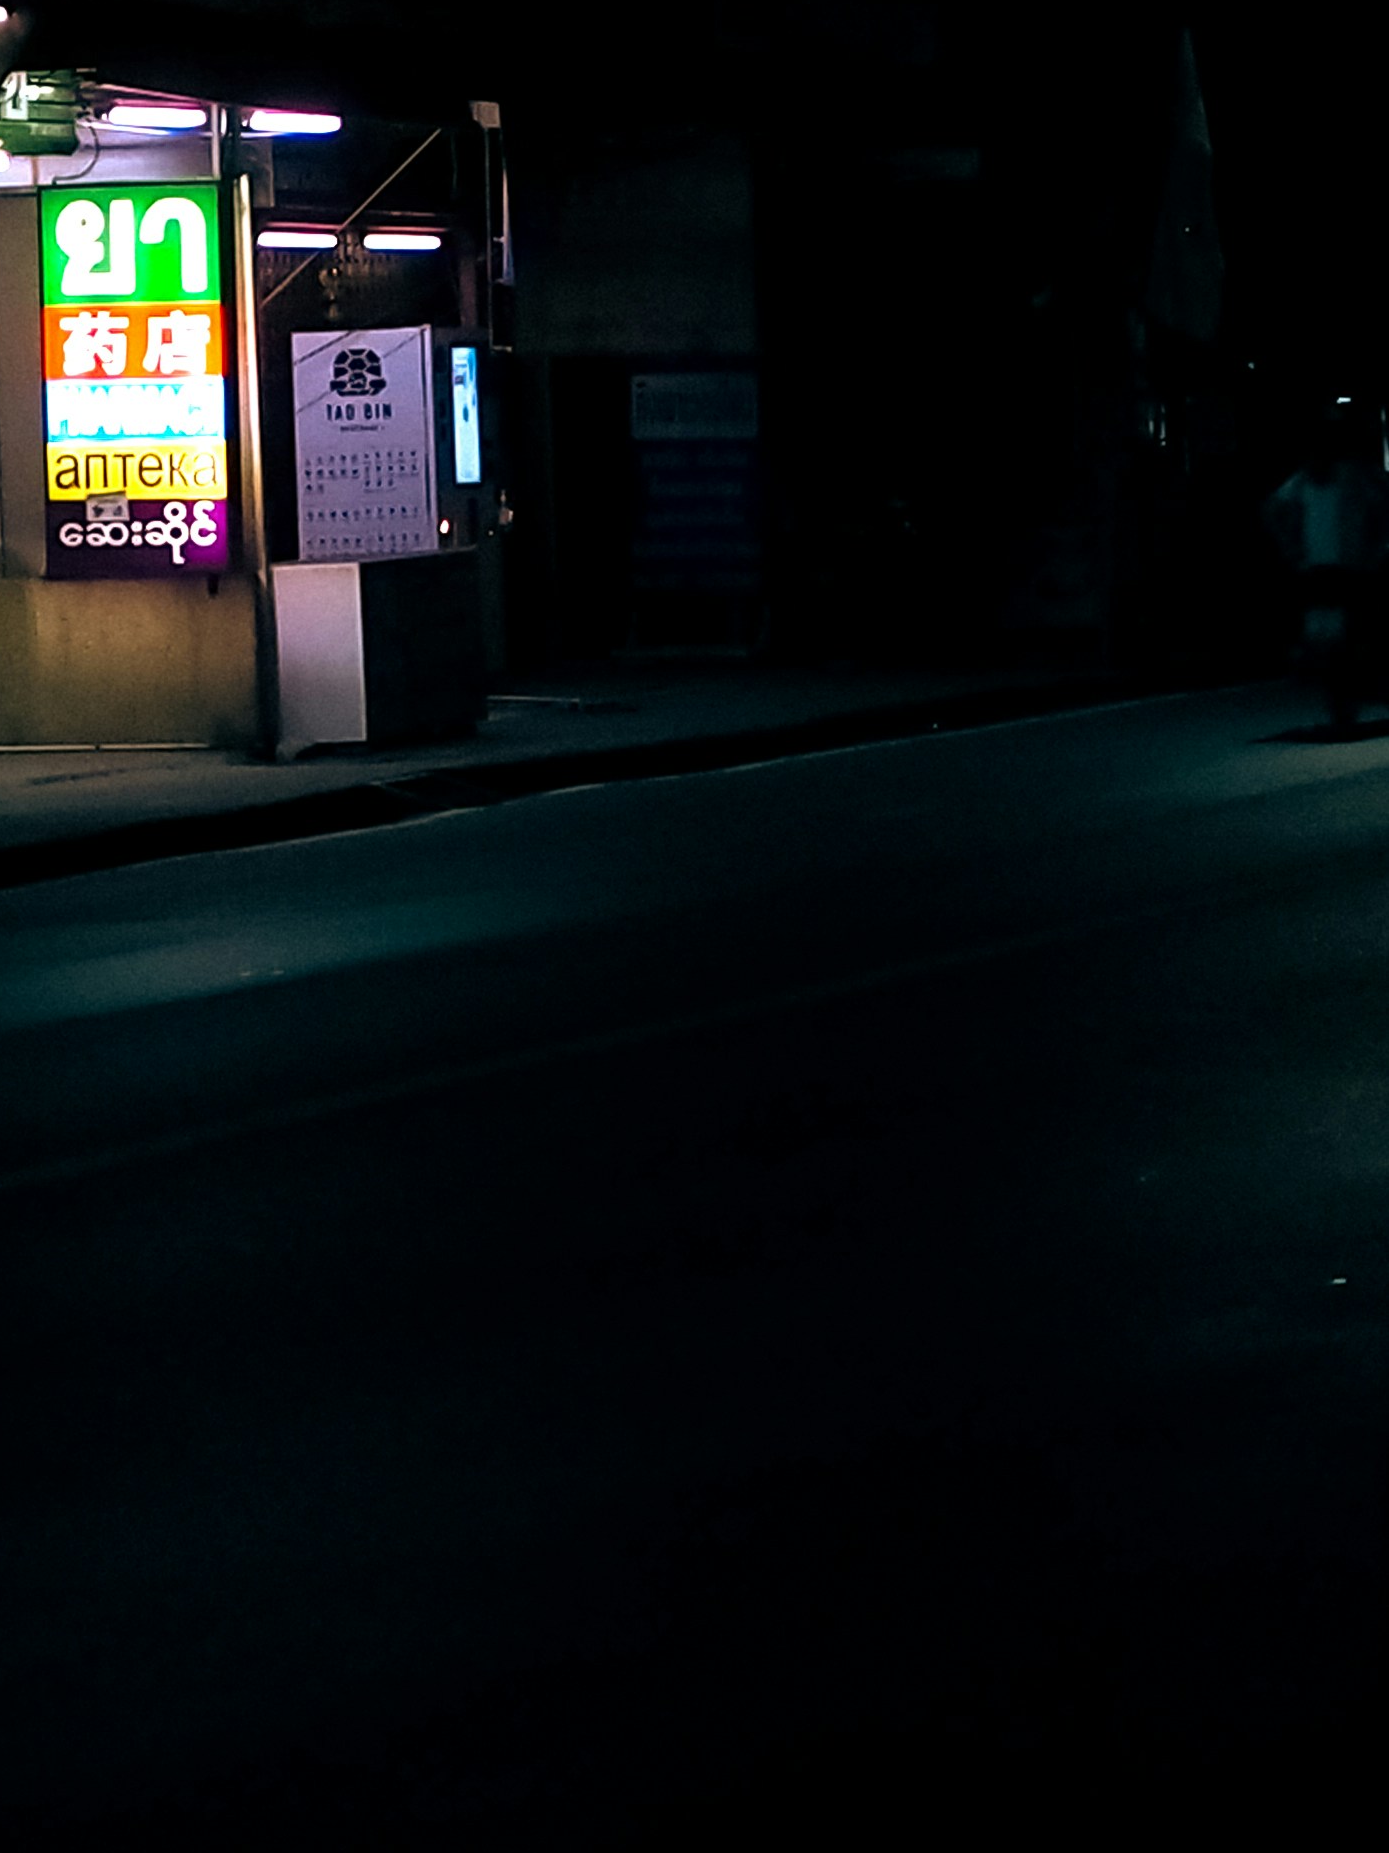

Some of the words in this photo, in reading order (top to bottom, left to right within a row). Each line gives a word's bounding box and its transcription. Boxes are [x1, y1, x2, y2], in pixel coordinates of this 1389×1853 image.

[55, 197, 209, 296] ยา
[59, 310, 211, 377] 药店
[364, 402, 392, 420] BIN
[55, 450, 218, 490] аптека
